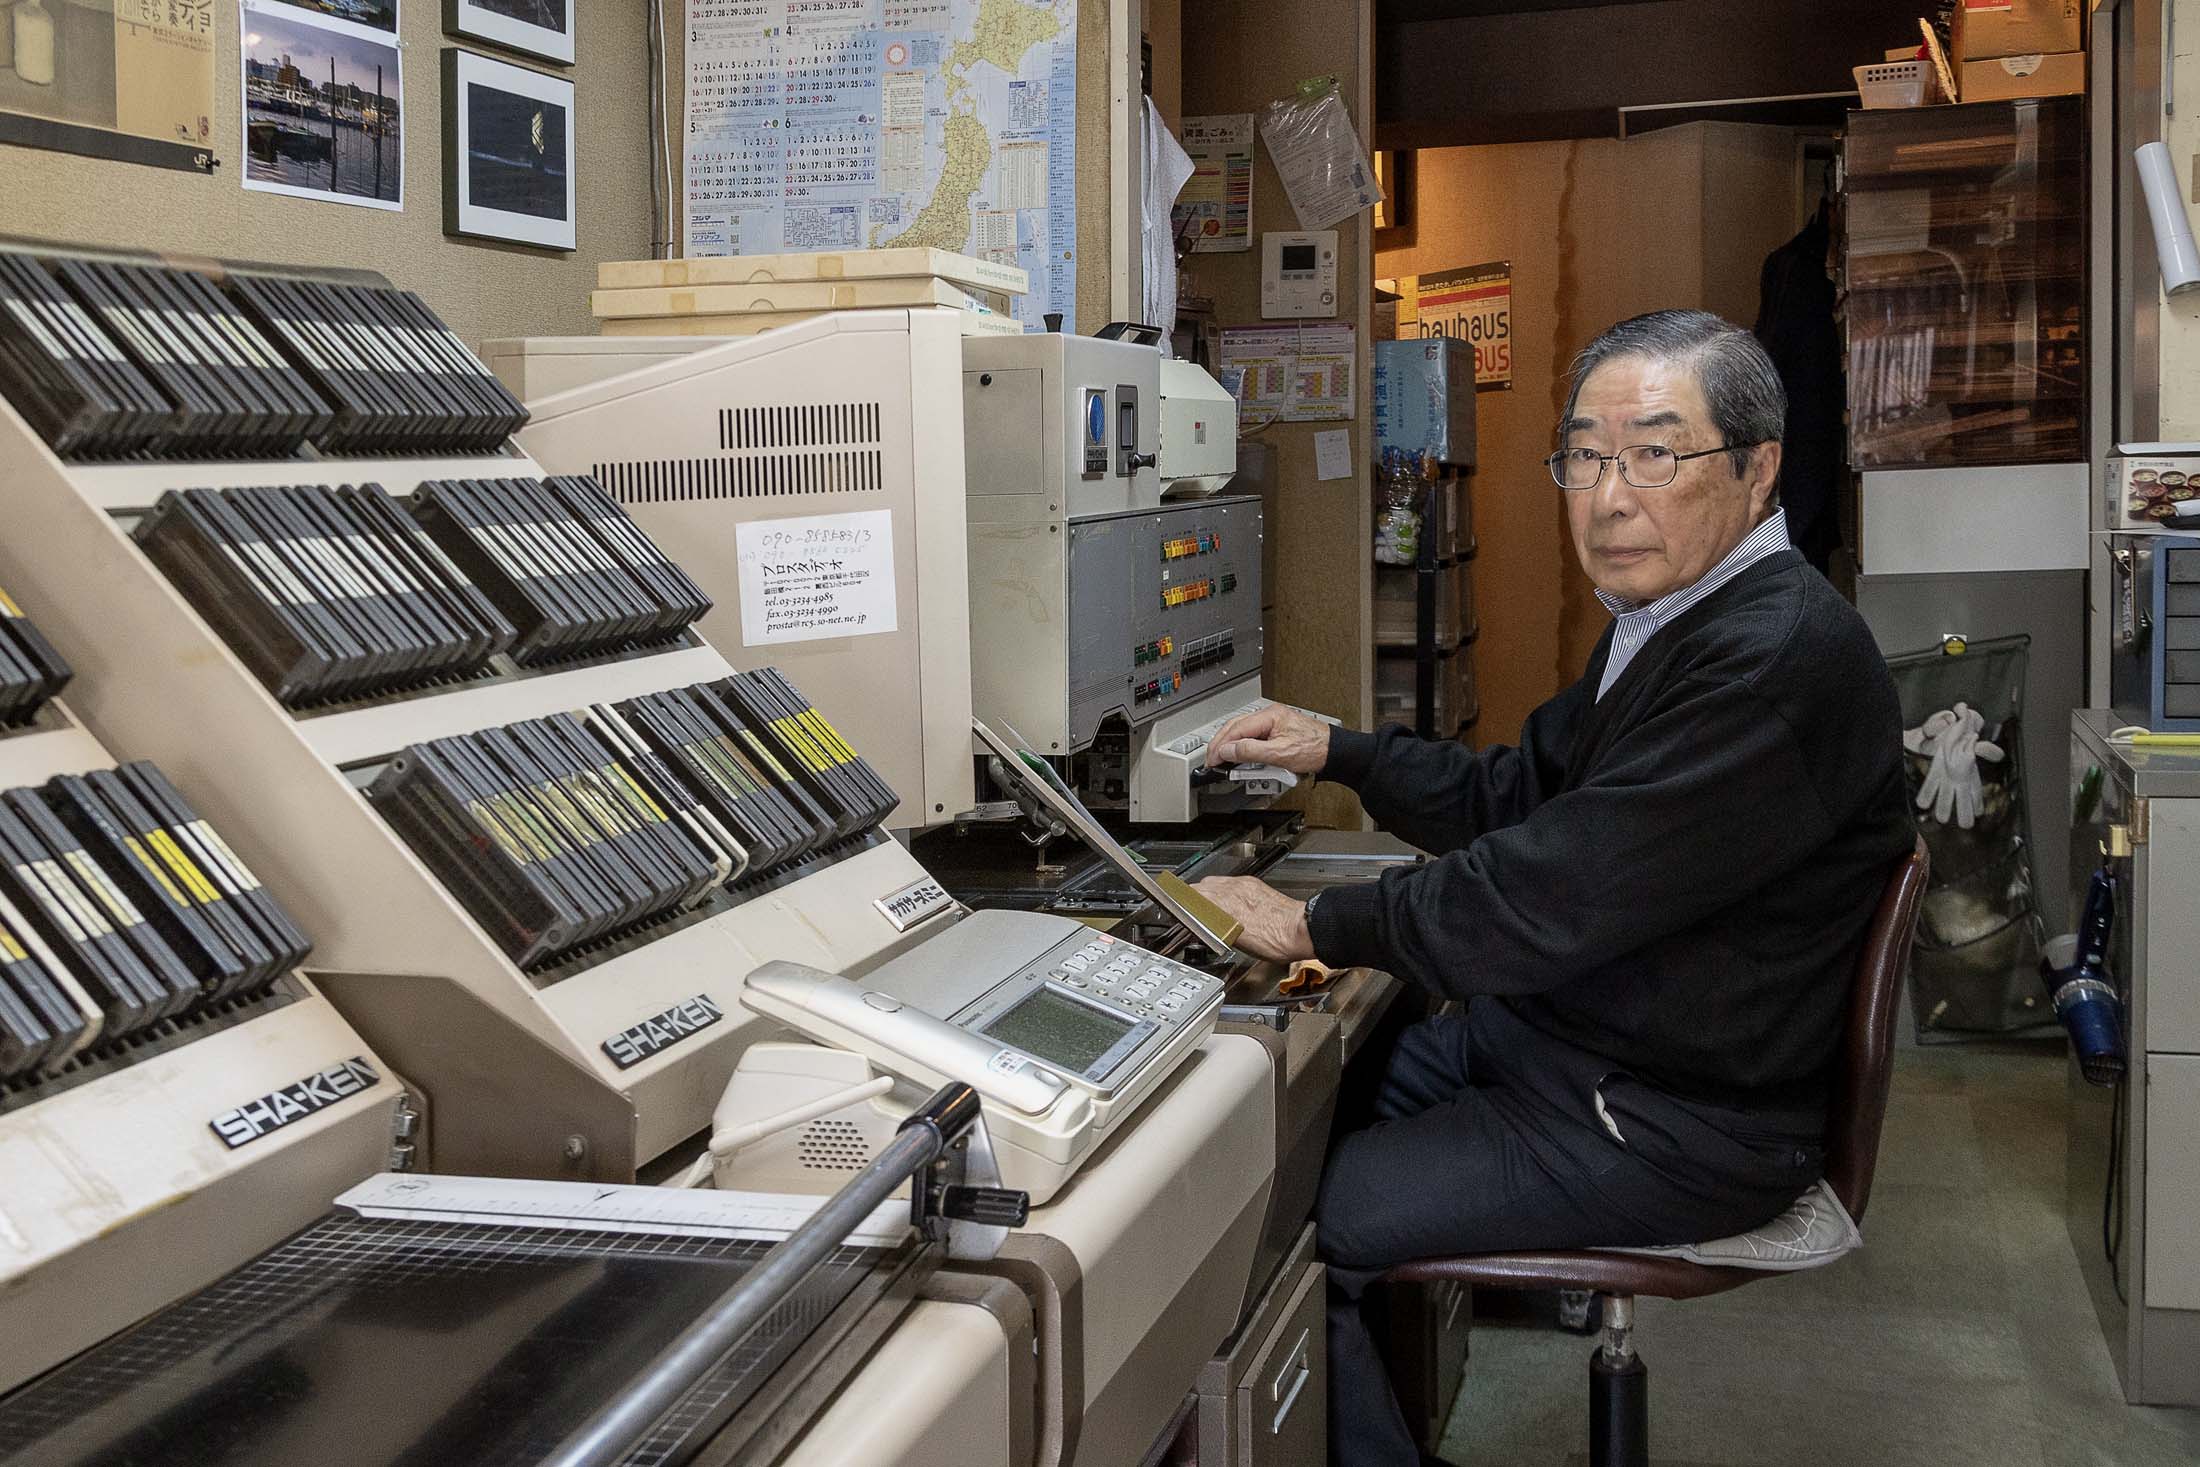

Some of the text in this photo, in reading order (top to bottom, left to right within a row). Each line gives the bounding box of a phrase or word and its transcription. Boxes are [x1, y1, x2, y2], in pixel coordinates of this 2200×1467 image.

[692, 31, 697, 42] 3
[786, 26, 792, 37] 4
[690, 122, 696, 133] 5
[785, 118, 791, 129] 6
[1420, 312, 1509, 341] bauhaus
